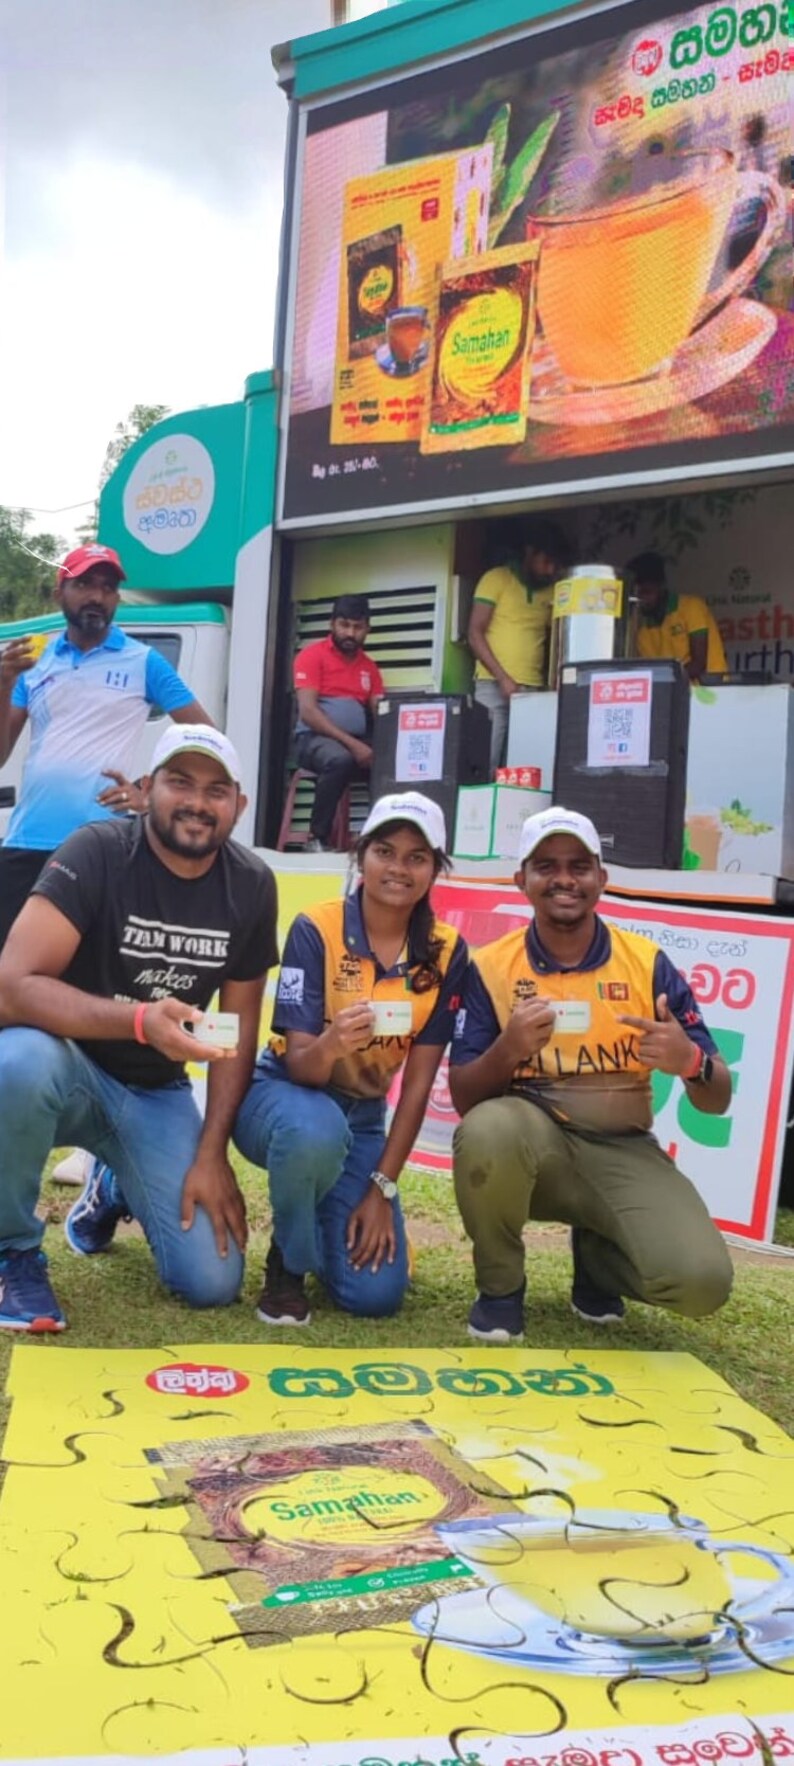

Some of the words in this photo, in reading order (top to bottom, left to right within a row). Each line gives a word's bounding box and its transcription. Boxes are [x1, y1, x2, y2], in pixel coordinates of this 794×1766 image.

[452, 329, 510, 355] Samahan
[123, 925, 166, 948] TEAM
[168, 934, 229, 958] WORK
[133, 965, 198, 990] makes
[268, 1361, 614, 1398] සමහන්
[270, 1490, 417, 1521] Samahan
